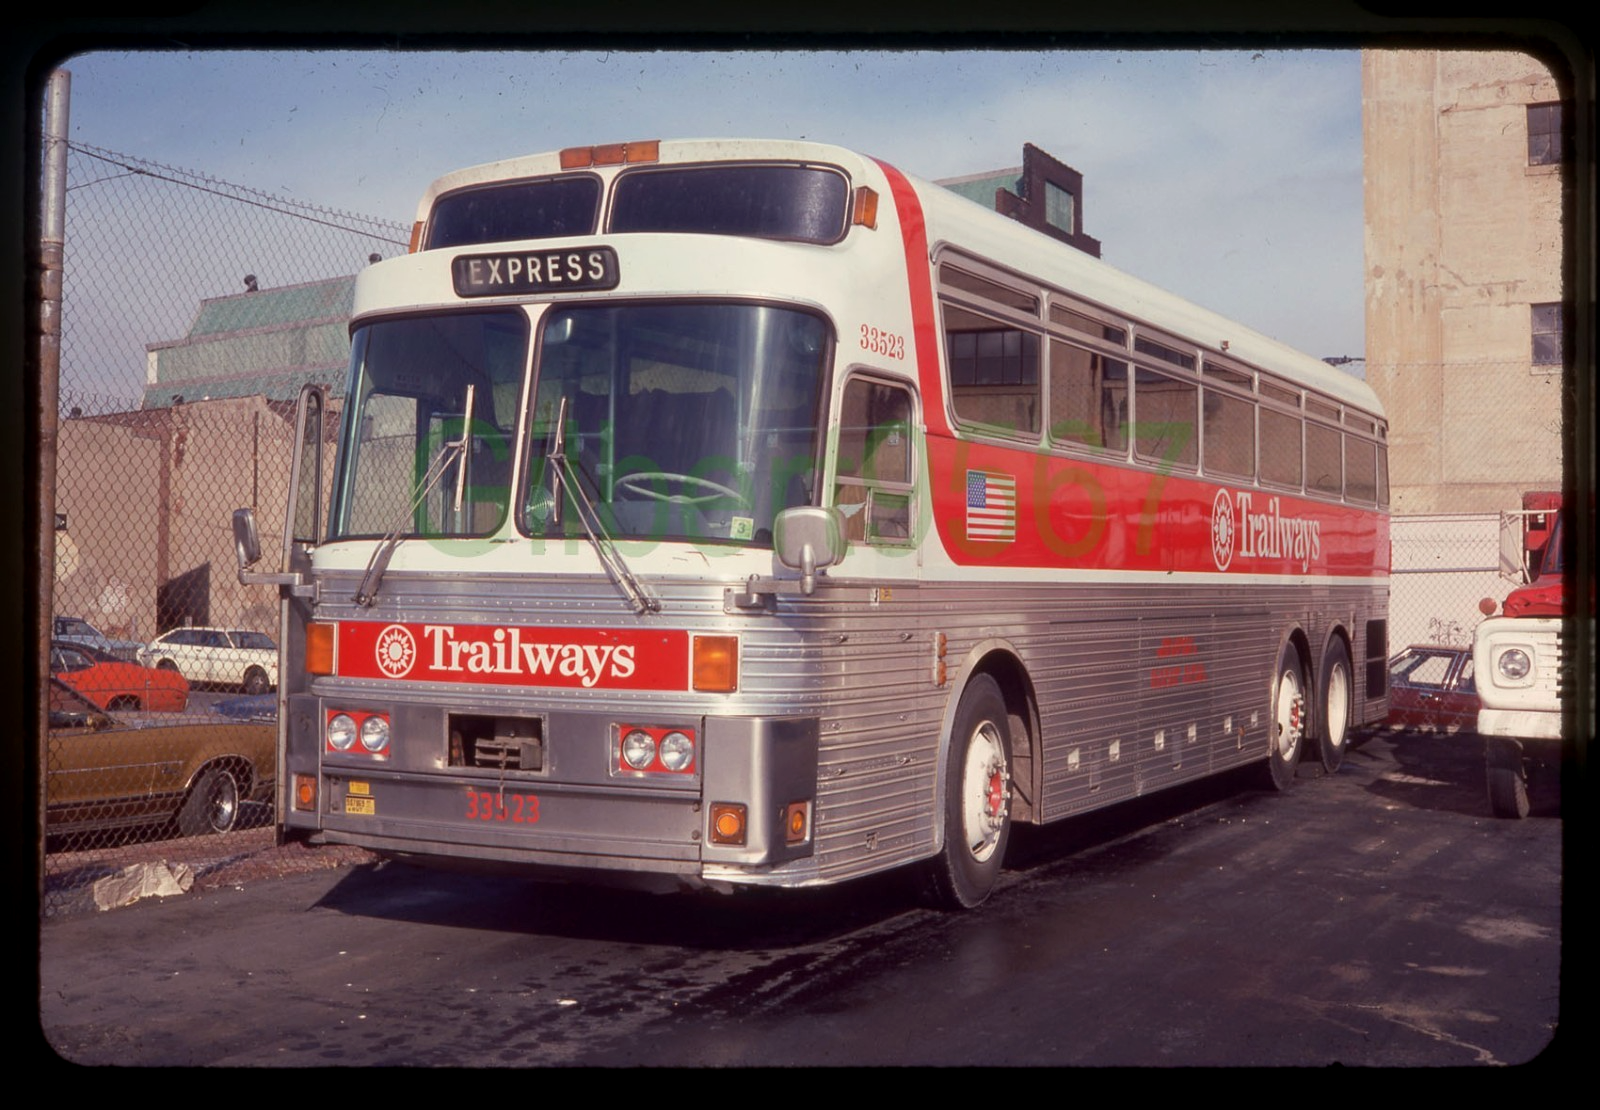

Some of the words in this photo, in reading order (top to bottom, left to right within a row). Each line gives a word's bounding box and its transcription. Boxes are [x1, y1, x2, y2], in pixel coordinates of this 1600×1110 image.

[469, 253, 604, 285] EXPRESS
[860, 323, 905, 361] 33523
[1237, 491, 1320, 572] Trailways
[424, 625, 635, 687] Trailways
[465, 791, 540, 823] 33523
